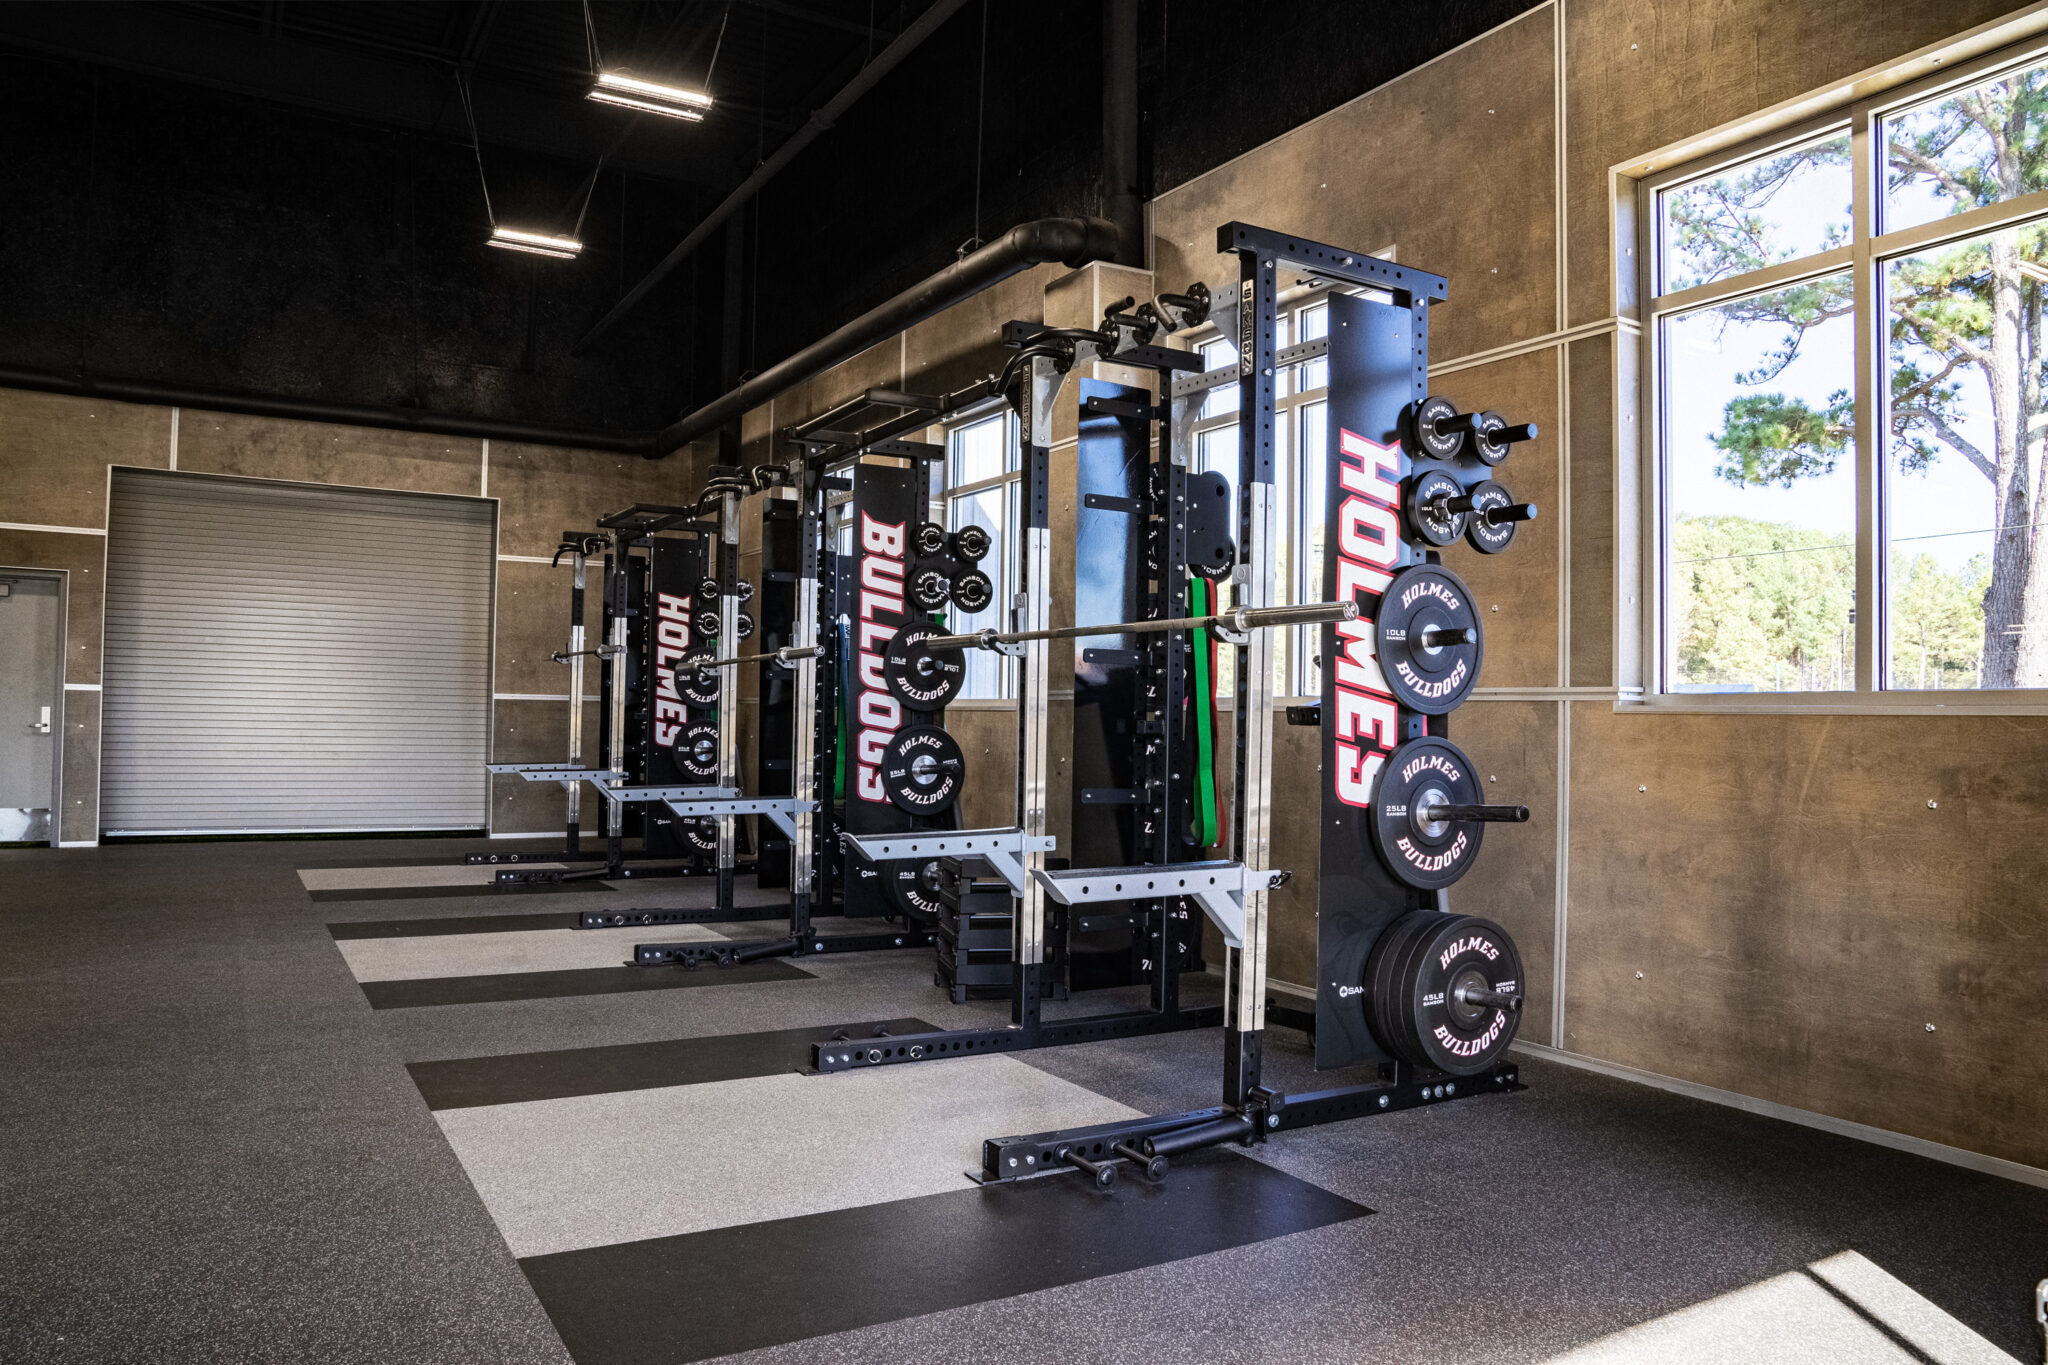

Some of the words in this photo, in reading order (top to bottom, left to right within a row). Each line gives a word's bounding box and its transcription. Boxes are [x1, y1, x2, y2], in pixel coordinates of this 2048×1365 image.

[1482, 418, 1503, 429] SAMSO
[1425, 482, 1454, 499] SAMSO
[1480, 492, 1508, 506] SAMSO
[1476, 520, 1508, 542] SAMSON
[1401, 582, 1460, 611] HOLMES
[1335, 427, 1400, 808] HOLMES
[905, 632, 938, 647] HOLM
[857, 509, 906, 804] BULLDOGS
[655, 592, 691, 747] HOLMES
[1396, 658, 1467, 698] BULLDOGS
[685, 688, 720, 703] BULLDO
[896, 676, 950, 701] BULLDOGS
[898, 735, 943, 757] HOLMES
[683, 759, 719, 775] BULLDOG
[1401, 755, 1461, 784] HOLMES
[900, 775, 954, 805] BULLDOGS
[688, 832, 717, 850] BULLD
[1396, 830, 1468, 872] BULLDOGS
[906, 890, 940, 913] BULL
[1439, 936, 1500, 971] HOLMES
[1422, 992, 1444, 1001] 45LB
[1433, 1009, 1506, 1057] BULLDOGS
